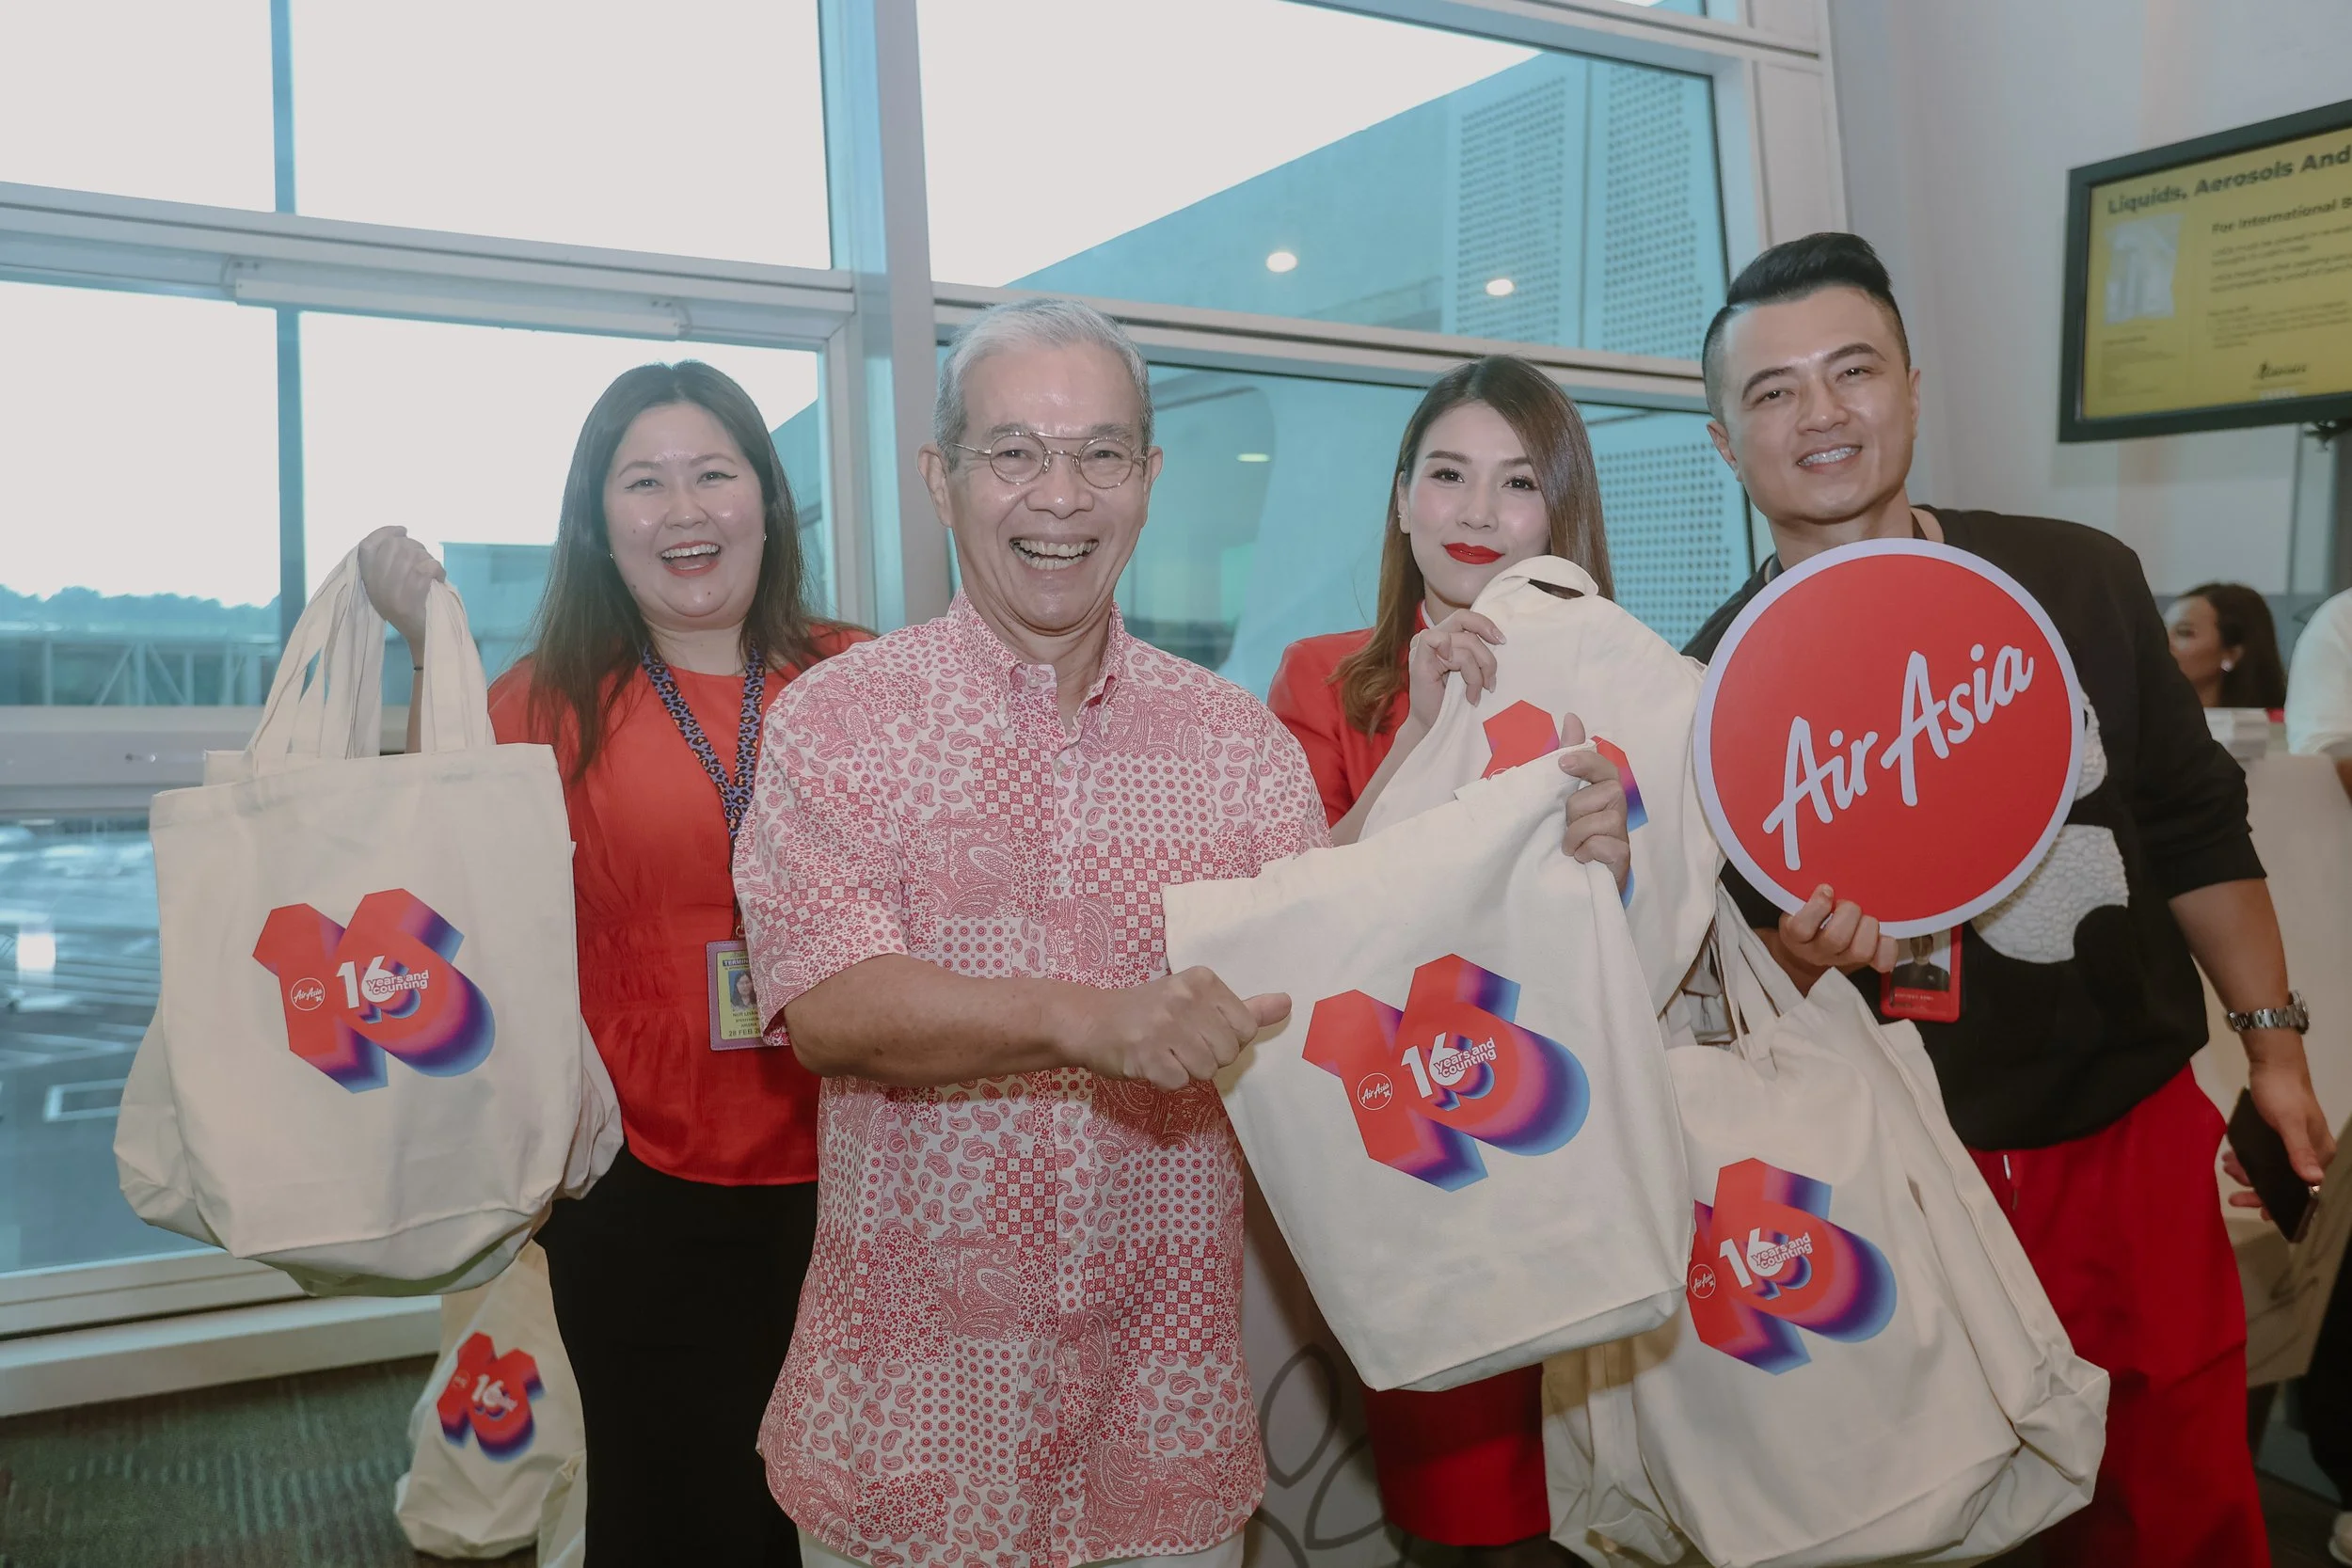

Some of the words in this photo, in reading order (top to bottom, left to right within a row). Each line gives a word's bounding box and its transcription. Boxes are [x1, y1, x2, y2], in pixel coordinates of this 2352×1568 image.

[2107, 184, 2187, 214] Liquids,
[2194, 160, 2295, 196] Aerosols
[2299, 144, 2352, 173] And
[2211, 222, 2234, 234] For
[2239, 198, 2337, 230] International
[336, 955, 396, 1008] 16
[368, 974, 404, 990] years
[405, 970, 429, 981] and
[373, 979, 428, 995] counting
[1401, 1032, 1466, 1099] 16
[1434, 1050, 1470, 1074] years
[1471, 1037, 1496, 1055] and
[1442, 1050, 1497, 1077] counting
[1719, 1227, 1785, 1288] 16
[1752, 1244, 1788, 1266] years
[1788, 1231, 1812, 1248] and
[1761, 1243, 1813, 1269] counting
